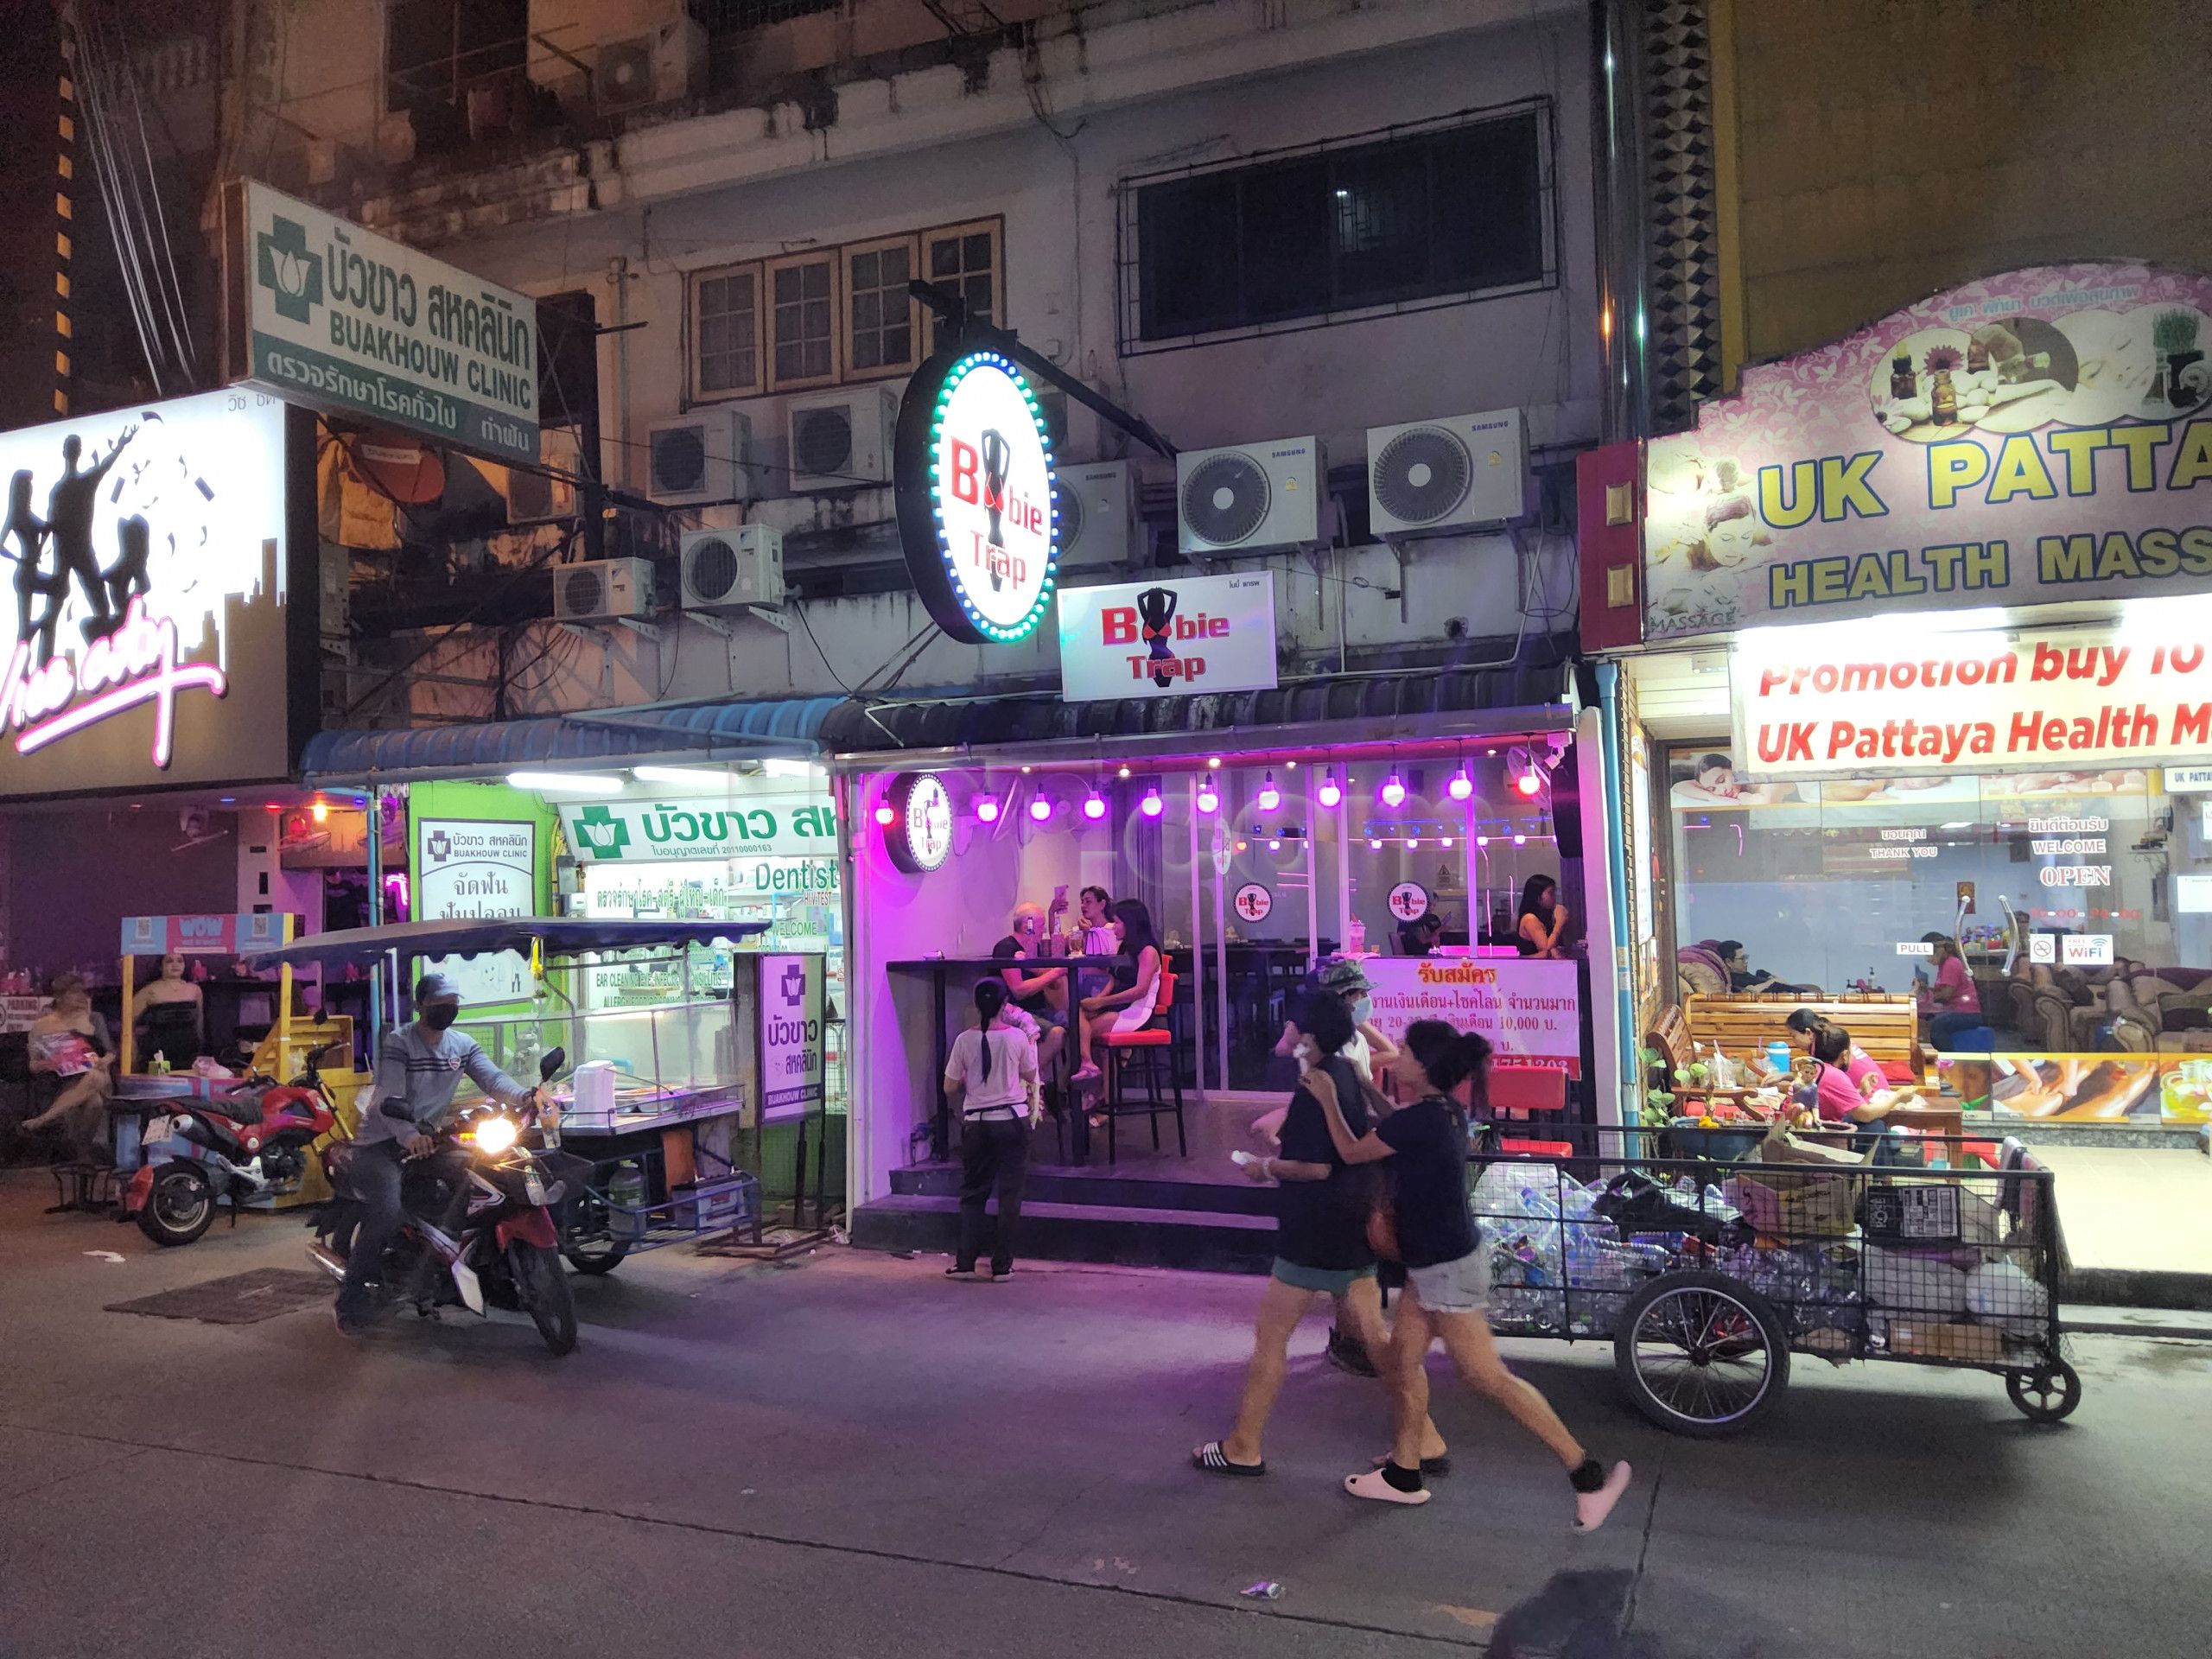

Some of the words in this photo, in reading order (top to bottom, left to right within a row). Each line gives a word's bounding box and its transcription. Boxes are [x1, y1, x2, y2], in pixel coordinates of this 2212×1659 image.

[328, 225, 417, 327] บัวขาว
[429, 285, 530, 370] สหคลินิก
[330, 310, 459, 385] BUAKHOUW
[467, 361, 531, 410] CLINIC
[481, 418, 530, 453] ทำฟัน
[1471, 420, 1510, 431] SAMSUNG
[1272, 448, 1306, 458] SAMSUNG
[1085, 472, 1117, 481] SAMSUNG
[1758, 450, 1890, 530] UK
[1928, 419, 2212, 510] PATTA
[970, 530, 1027, 589] Trap
[1769, 540, 2010, 610] HEALTH
[2037, 526, 2212, 585] MASS
[1127, 656, 1206, 683] Trap
[1759, 651, 2018, 696] Promotion
[2031, 641, 2132, 687] buy
[1758, 722, 1820, 763] UK
[1827, 718, 1996, 765] Pattaya
[2007, 702, 2159, 753] Health
[2174, 772, 2185, 783] UK
[642, 804, 778, 842] บัวขาว
[453, 832, 484, 846] บัวขาว
[489, 834, 528, 847] สหคลินิก
[2031, 839, 2107, 855] WELCOME
[454, 849, 500, 858] BUAKHOUW
[502, 849, 528, 858] CLINIC
[1870, 848, 1910, 858] THANK
[1911, 847, 1937, 858] YOU
[454, 871, 508, 896] จัดฟัน
[755, 859, 838, 891] Dentist
[2040, 866, 2111, 887] OPEN
[770, 921, 817, 936] WELCOME
[1900, 944, 1929, 953] PULL
[2069, 947, 2101, 958] WiFi
[596, 973, 608, 987] EAR
[1418, 962, 1497, 983] รับสมัคร
[1508, 992, 1576, 1011] จำนวนมาก
[768, 1014, 818, 1046] บัวขาว
[1499, 1015, 1539, 1030] 10,000
[1544, 1019, 1558, 1031] บ.
[785, 1049, 817, 1075] สหคลินิก
[767, 1089, 800, 1106] BUAKHOUW
